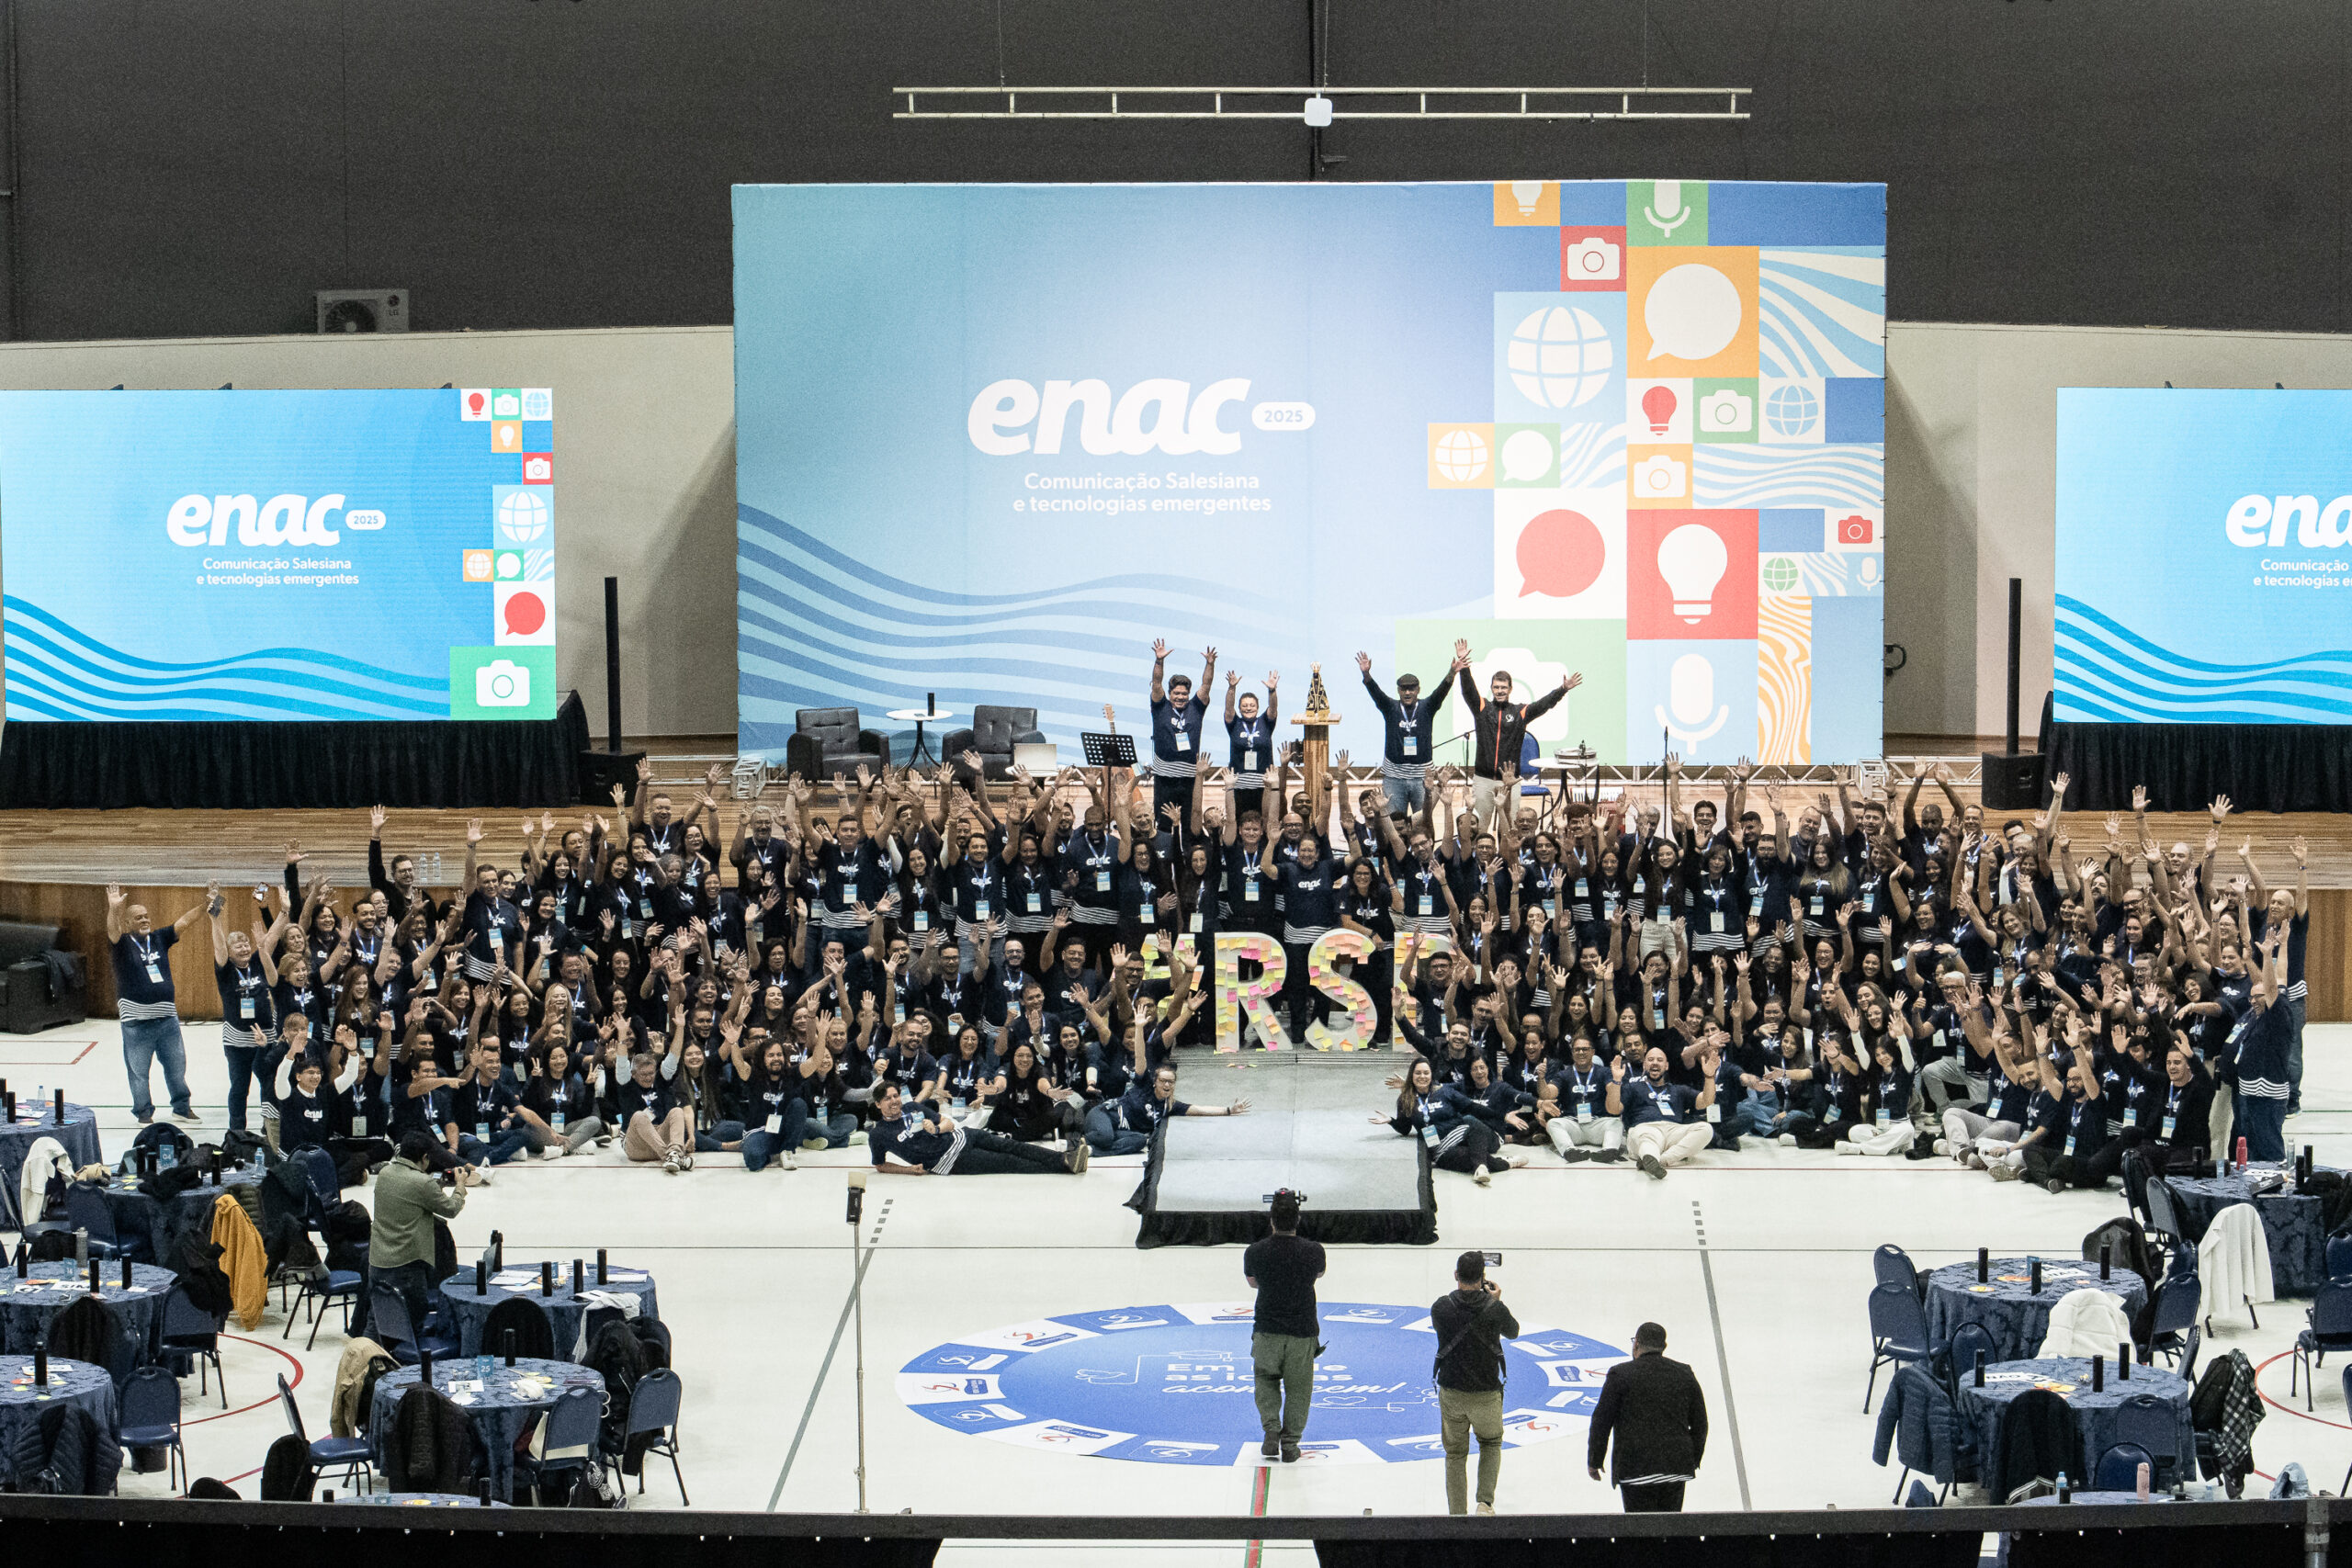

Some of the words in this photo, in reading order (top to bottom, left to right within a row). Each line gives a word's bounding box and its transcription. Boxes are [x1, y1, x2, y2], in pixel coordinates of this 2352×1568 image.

[967, 378, 1251, 456] enac
[1263, 410, 1304, 423] 2025
[1023, 472, 1160, 492] Comunicação
[1166, 472, 1260, 490] Salesiana
[1012, 499, 1025, 512] e
[1030, 494, 1147, 515] tecnologias
[1151, 496, 1272, 515] emergentes
[166, 493, 345, 547] enac
[353, 515, 379, 525] 2025
[2225, 493, 2352, 548] ena
[203, 557, 289, 572] Comunicação
[292, 557, 352, 570] Salesiana
[2261, 558, 2349, 575] Comunicação
[196, 574, 204, 584] e
[207, 571, 280, 587] tecnologias
[283, 573, 359, 587] emergentes
[2253, 577, 2262, 587] e
[2265, 574, 2340, 589] tecnologias
[1298, 878, 1321, 888] enac
[1168, 1363, 1235, 1371] Em
